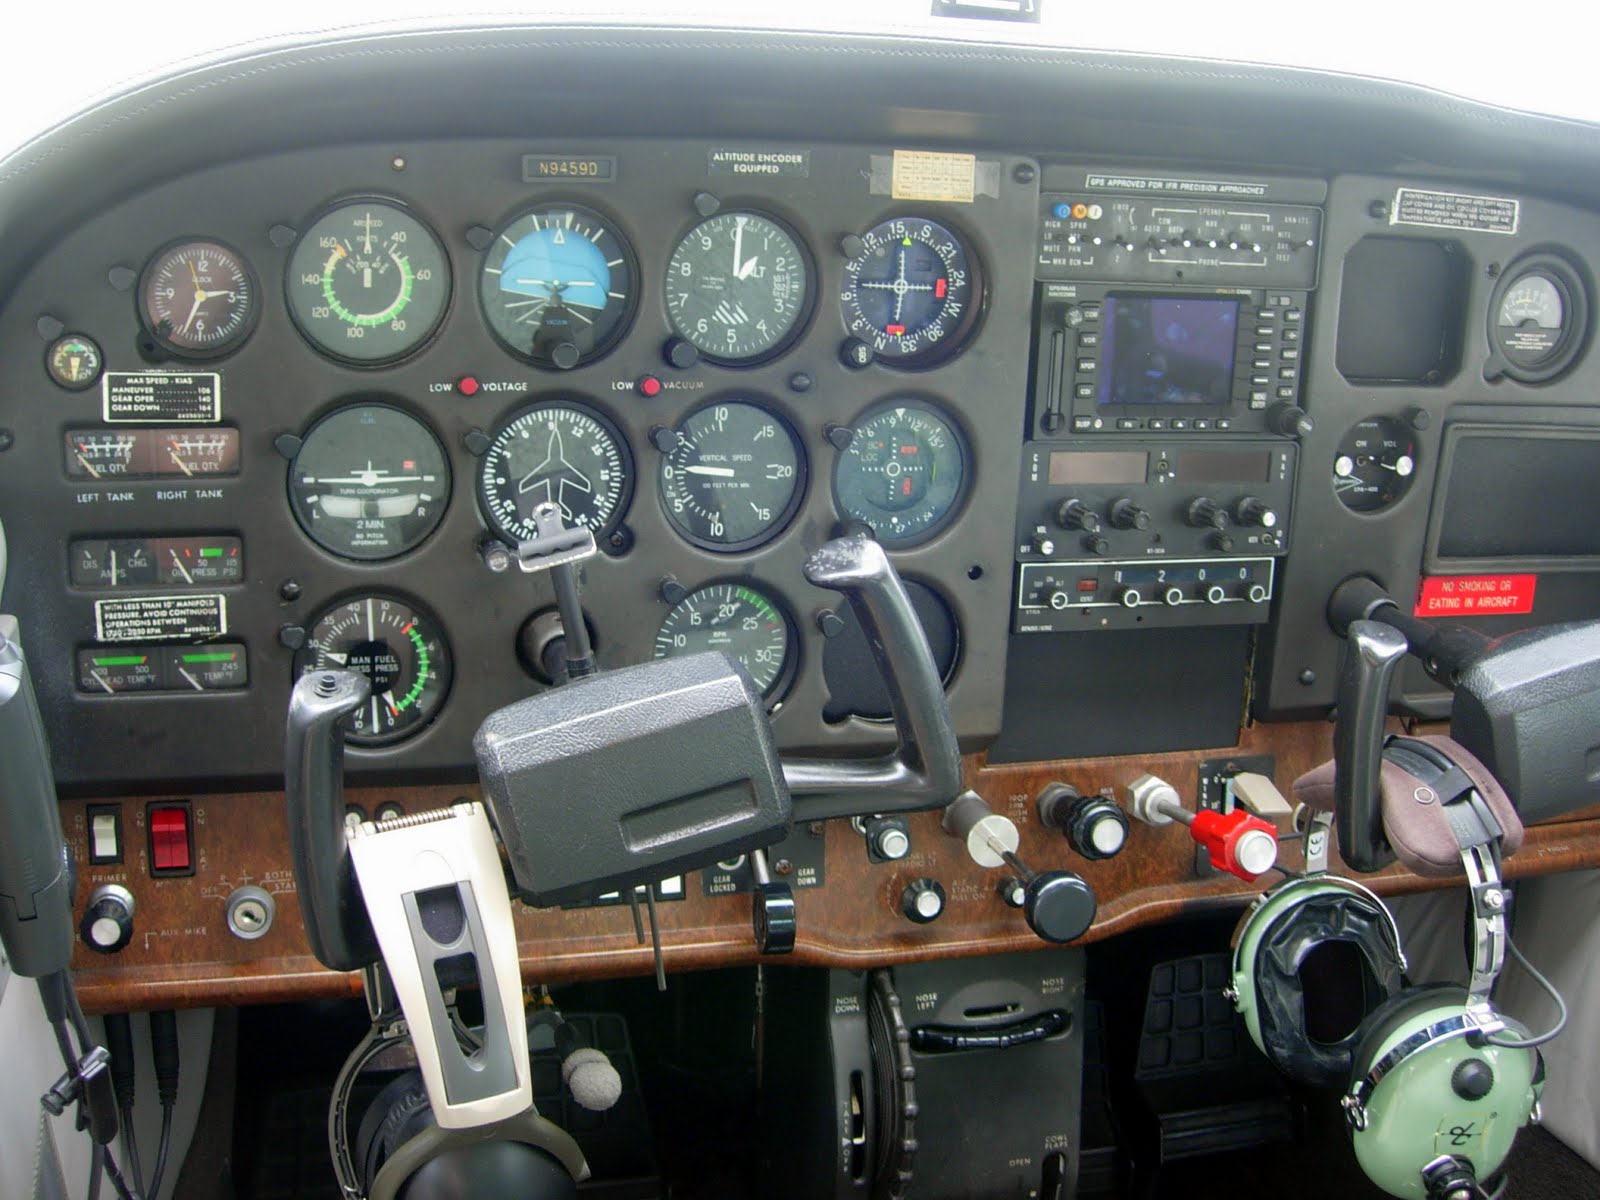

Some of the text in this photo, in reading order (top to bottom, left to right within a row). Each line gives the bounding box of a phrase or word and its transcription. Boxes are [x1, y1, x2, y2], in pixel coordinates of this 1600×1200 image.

[713, 152, 802, 163] ALTITUDE ENCODER
[734, 164, 779, 174] EQUIPPED
[1090, 178, 1264, 195] GPS APPROVED FOR IFR PRECISION APPROACHES
[890, 222, 905, 234] 15
[921, 225, 932, 237] S
[391, 231, 406, 242] 40
[320, 237, 336, 248] 160
[702, 237, 712, 250] 9
[681, 262, 691, 276] 8
[776, 258, 785, 271] 2
[302, 274, 320, 284] 140
[417, 270, 431, 280] 60
[953, 270, 966, 287] 24
[678, 293, 688, 307] 7
[774, 300, 784, 312] 3
[949, 302, 962, 317] W
[312, 307, 329, 318] 120
[196, 319, 204, 330] 6
[391, 320, 406, 331] 80
[698, 319, 708, 333] 6
[756, 320, 768, 332] 4
[347, 328, 364, 338] 100
[727, 329, 736, 343] 5
[902, 340, 917, 352] 33
[430, 382, 527, 392] LOW VOLTAGE
[612, 381, 704, 390] LOW VACUUM
[715, 407, 728, 421] 10
[890, 418, 896, 428] 9
[911, 420, 921, 431] 12
[521, 430, 529, 439] 6
[571, 426, 584, 437] 12
[762, 426, 774, 437] 15
[861, 453, 878, 461] LOC
[664, 466, 673, 479] 0
[777, 465, 792, 477] 20
[77, 493, 134, 503] LEFT TANK
[157, 490, 223, 500] RIGHT TANK
[674, 499, 683, 512] 5
[313, 510, 320, 518] L
[418, 508, 425, 516] R
[758, 509, 770, 520] 15
[710, 523, 723, 536] 10
[198, 559, 208, 567] 50
[191, 567, 237, 576] PRESS PSI
[1158, 570, 1166, 582] 2
[1442, 581, 1511, 592] NO SMOKING OR
[104, 603, 122, 611] WITH
[176, 599, 214, 607] MANIFOLD
[381, 602, 389, 610] 10
[1429, 596, 1518, 609] EATING IN AIRCRAFT
[143, 610, 167, 618] AVOID
[169, 608, 218, 616] CONTINUOUS
[719, 604, 735, 617] 20
[105, 619, 151, 628] OPERATIONS
[412, 617, 418, 625] 8
[691, 613, 701, 625] 15
[743, 618, 758, 630] 25
[674, 635, 686, 647] 10
[352, 656, 371, 664] MAN
[755, 650, 771, 662] 30
[375, 664, 399, 672] PRESS
[416, 700, 421, 708] 2
[388, 717, 394, 725] 0
[137, 811, 144, 827] ON
[197, 809, 205, 825] ON
[265, 871, 292, 879] BOTH
[798, 868, 815, 876] GEAR
[92, 874, 127, 882] PRIMER
[797, 876, 816, 885] DOWN
[710, 883, 736, 892] LOCKED
[185, 927, 207, 935] MIKE
[1042, 978, 1064, 987] NOSE
[1042, 985, 1064, 994] RIGHT
[836, 997, 857, 1005] NOSE
[916, 993, 937, 1002] NOSE
[836, 1004, 859, 1013] DOWN
[917, 1001, 935, 1010] LEFT
[1046, 1134, 1067, 1143] COWL
[1045, 1141, 1068, 1150] FLAPS
[1009, 1158, 1031, 1167] OPEN
